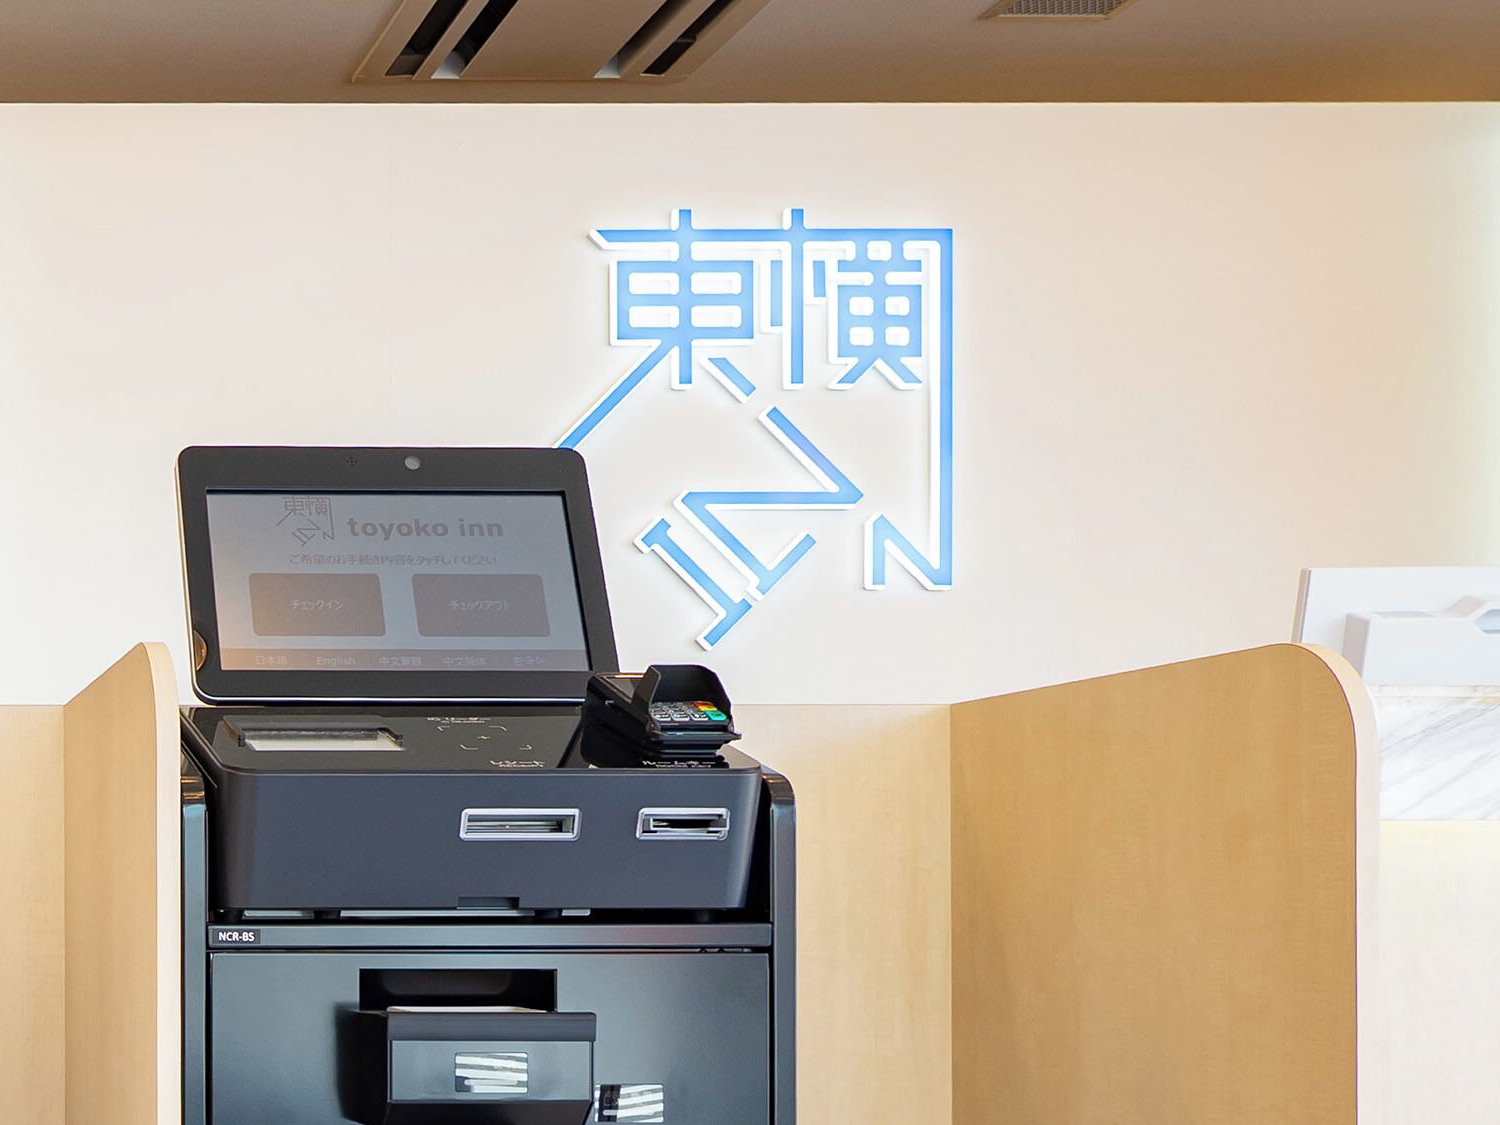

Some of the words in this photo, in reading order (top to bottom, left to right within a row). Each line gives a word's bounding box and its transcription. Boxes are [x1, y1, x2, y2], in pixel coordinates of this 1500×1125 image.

[347, 517, 449, 541] toyoko
[459, 518, 503, 537] inn
[290, 599, 344, 611] チェックイン
[450, 599, 510, 611] チェックアウト
[316, 655, 356, 668] English
[217, 930, 256, 942] NCR-BS
